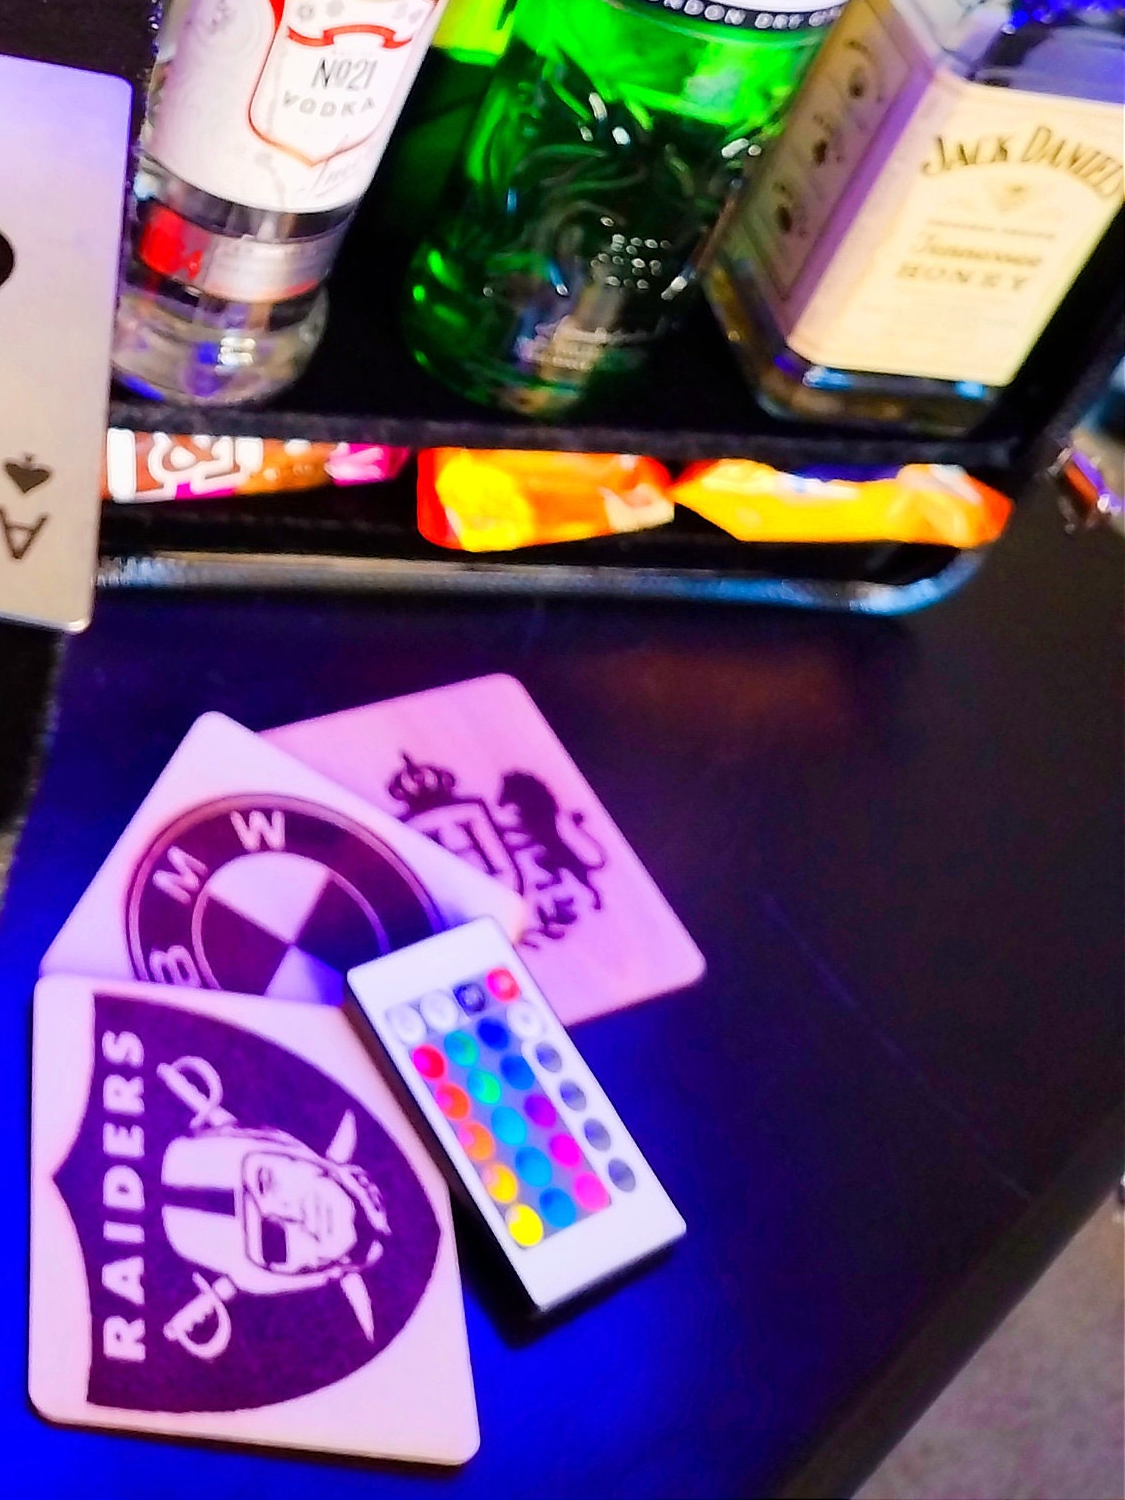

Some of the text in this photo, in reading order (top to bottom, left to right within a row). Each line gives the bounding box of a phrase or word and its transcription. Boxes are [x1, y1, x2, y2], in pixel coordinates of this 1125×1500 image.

[282, 89, 376, 118] VODKA
[922, 131, 1014, 175] JACK
[101, 1028, 146, 1362] RAIDERS
